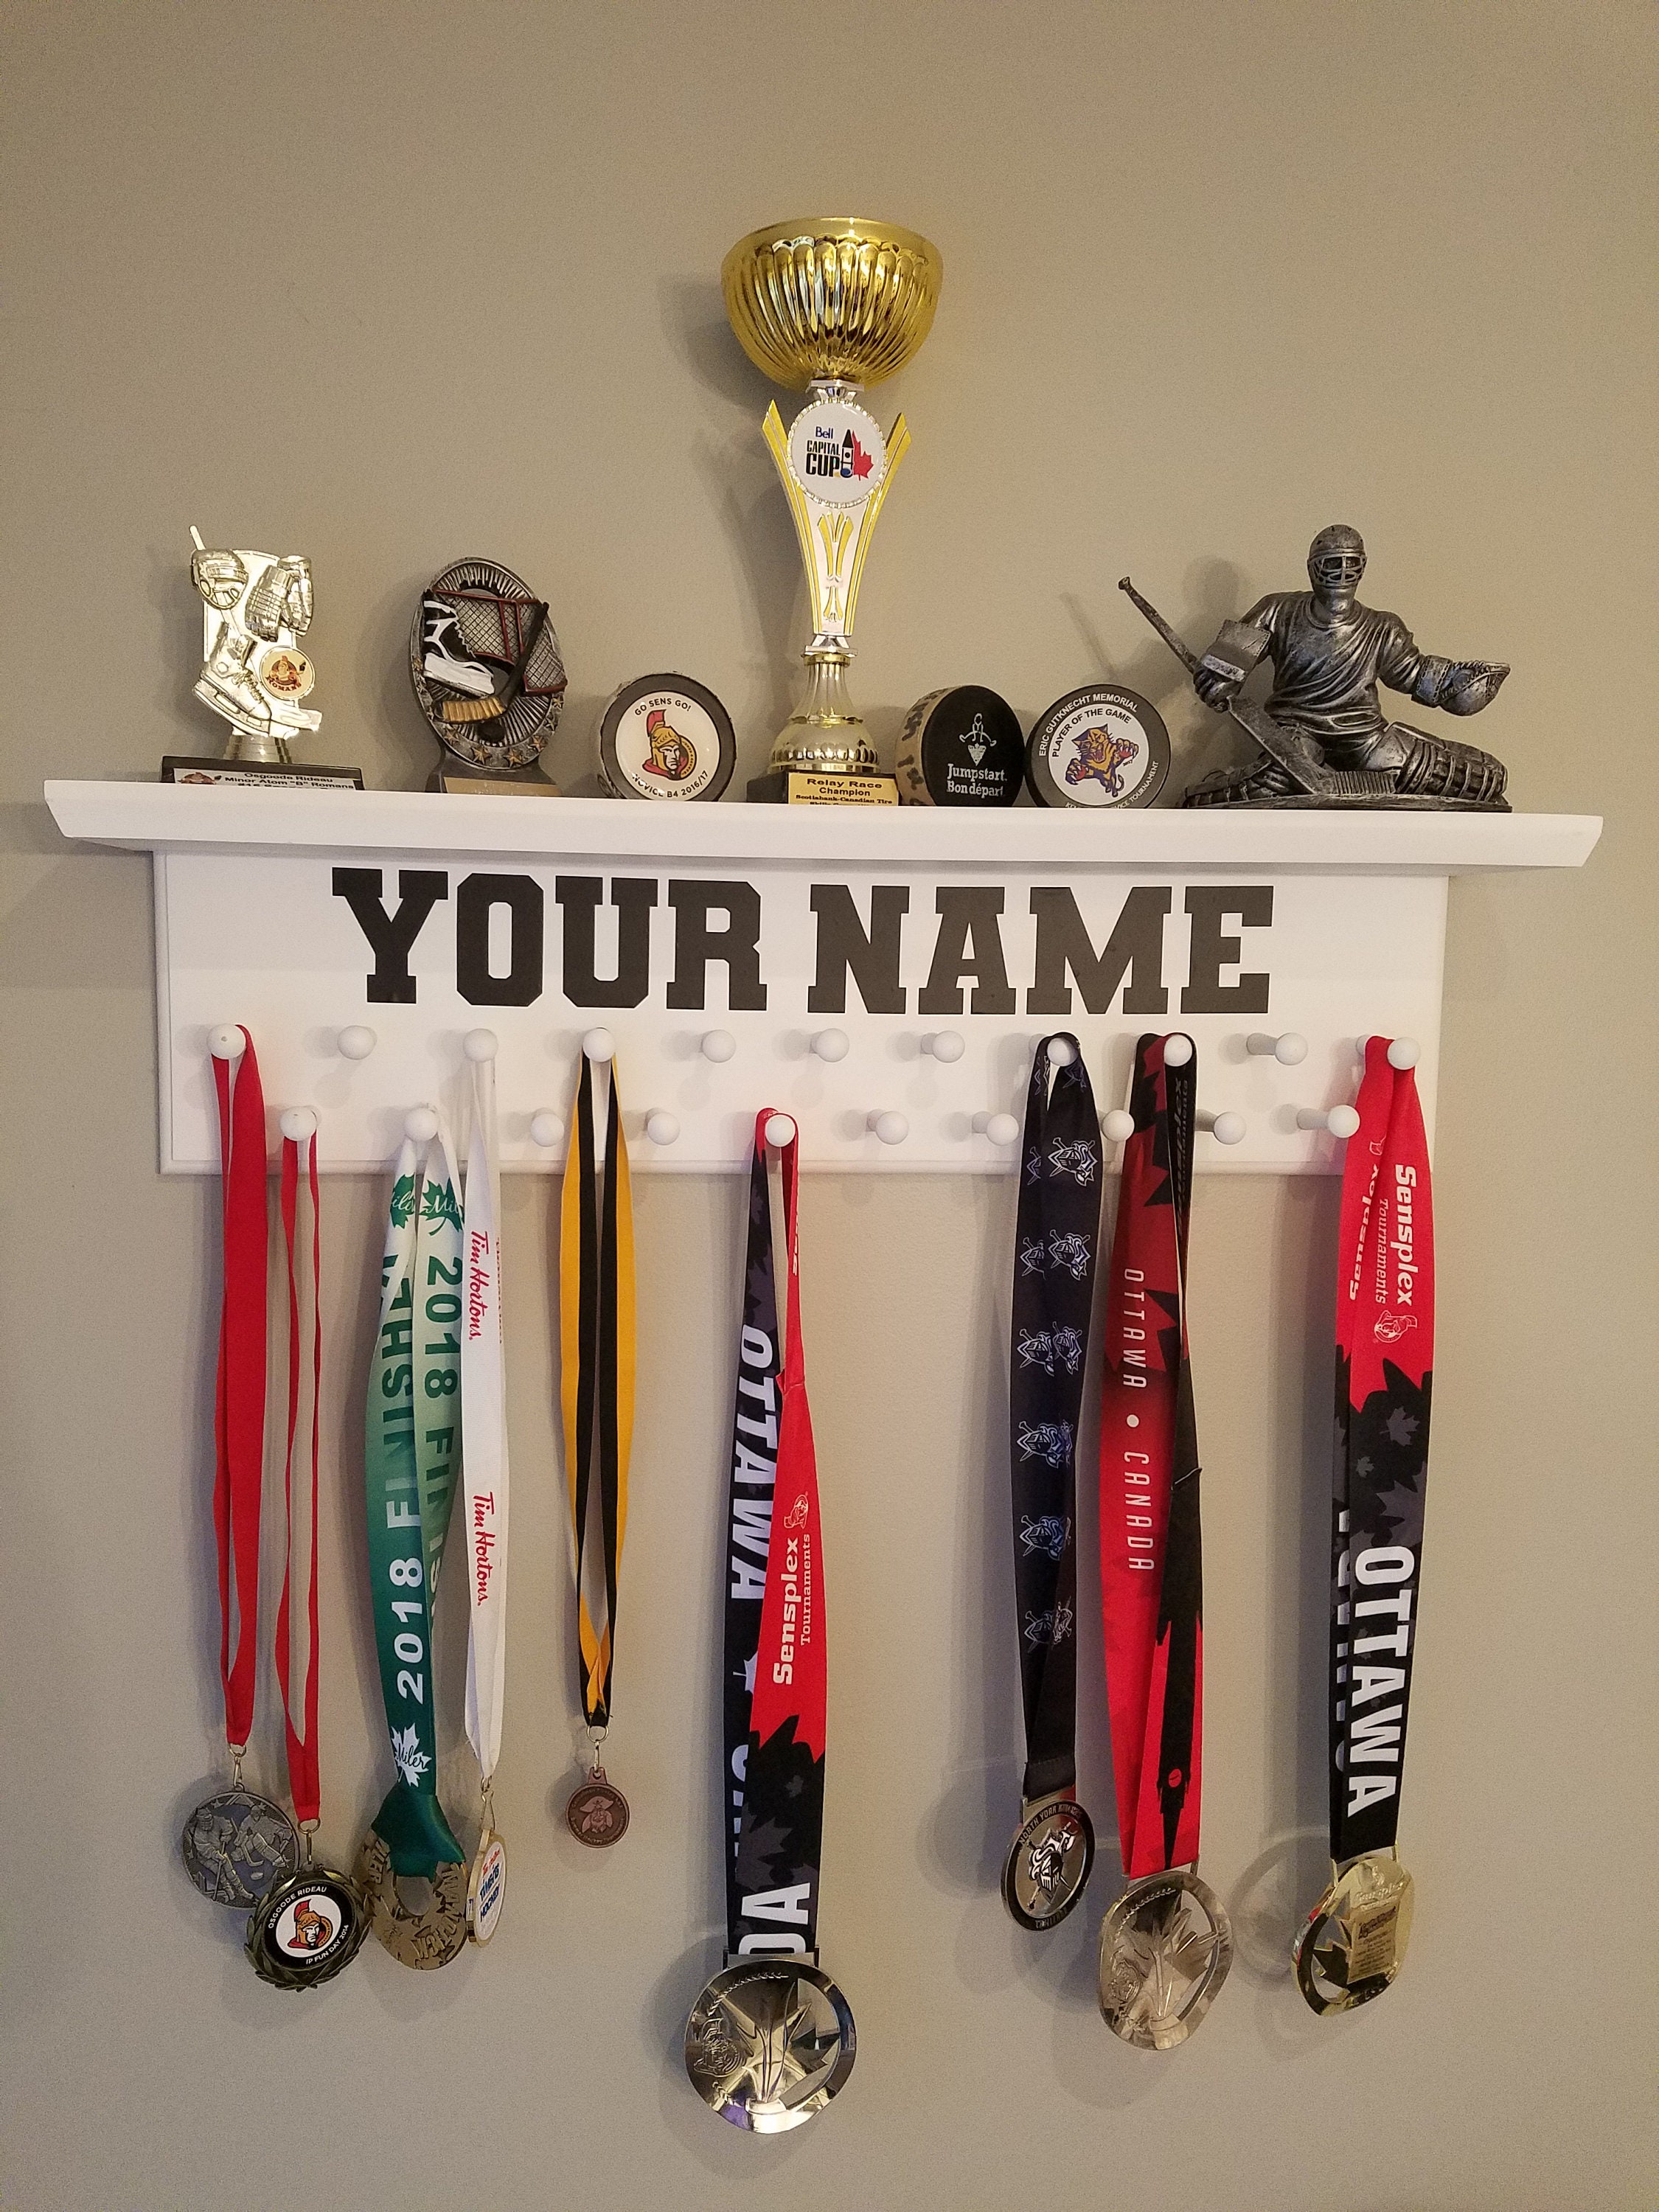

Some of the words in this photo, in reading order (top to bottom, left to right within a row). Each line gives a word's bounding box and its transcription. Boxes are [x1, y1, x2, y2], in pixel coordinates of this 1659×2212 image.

[807, 440, 841, 456] CAPITAL
[815, 426, 833, 439] Bell
[806, 453, 840, 477] CUP
[634, 704, 647, 716] GO
[649, 698, 672, 707] SENS
[675, 699, 692, 712] GO!
[1039, 734, 1050, 757] ERIC
[1046, 694, 1091, 734] GUTKNECHT
[1093, 693, 1139, 713] MEMORIAL
[1052, 723, 1072, 757] PLAYER
[1071, 713, 1084, 725] OF
[1085, 708, 1103, 718] THE
[1105, 708, 1132, 723] GAME
[681, 770, 708, 796] 2016/17
[807, 779, 844, 787] Relay
[819, 787, 871, 796] Champion
[947, 763, 1005, 782] Jumpstart
[1129, 761, 1159, 803] TOURNAMENT
[332, 866, 768, 1011] YOUR
[807, 883, 1274, 1015] NAME
[470, 1231, 490, 1264] Tim
[1375, 1198, 1389, 1304] Tournaments
[1390, 1164, 1419, 1306] Sensplex
[425, 1255, 463, 1399] 2018
[469, 1266, 490, 1339] Hortons
[1122, 1267, 1147, 1388] OTTAWA
[731, 1324, 779, 1600] OTTAWA
[473, 1492, 495, 1527] Tim
[1123, 1451, 1155, 1571] CANADA
[475, 1531, 496, 1604] Hortons
[801, 1534, 810, 1646] Tournaments
[389, 1557, 424, 1705] 2018
[773, 1537, 801, 1685] Sensplex
[1347, 1545, 1415, 1818] OTTAWA
[1018, 1818, 1040, 1844] NORTH
[268, 1893, 296, 1929] OSGOODE
[297, 1886, 327, 1896] RIDEAU
[314, 1950, 330, 1962] FUN
[328, 1938, 341, 1953] DAY
[339, 1924, 349, 1940] 2014
